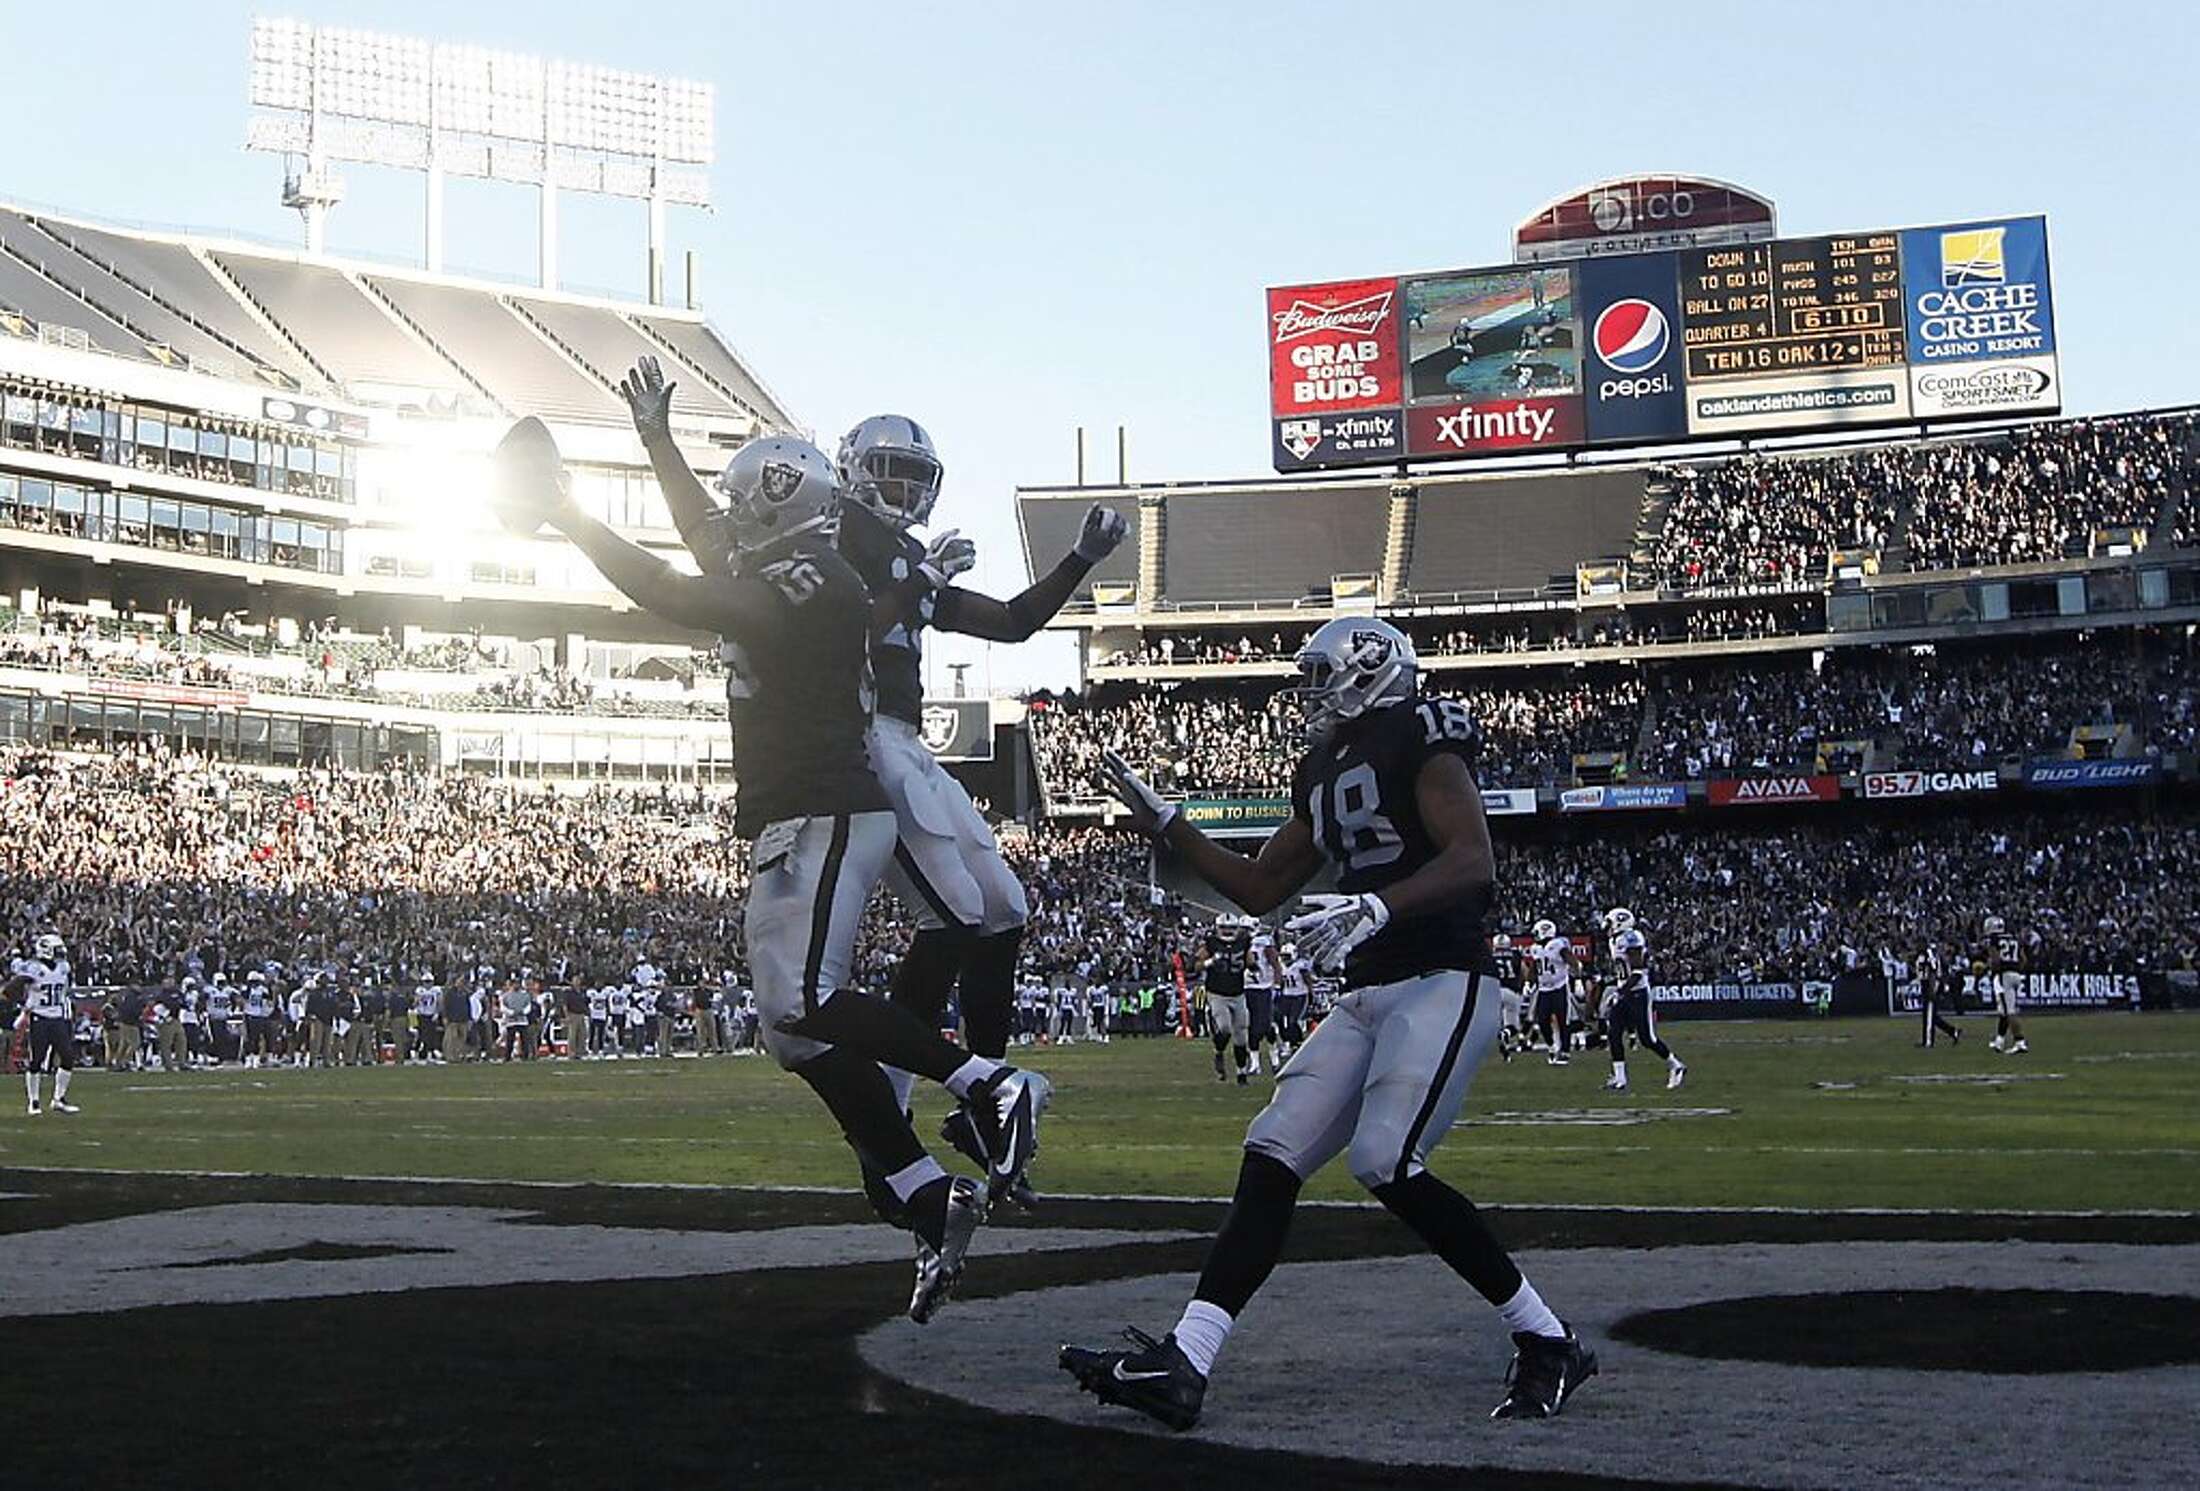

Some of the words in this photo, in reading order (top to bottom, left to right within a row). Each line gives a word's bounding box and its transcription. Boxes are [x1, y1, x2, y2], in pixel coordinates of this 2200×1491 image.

[1707, 252, 1744, 268] DOWN
[1753, 250, 1761, 264] 1
[1700, 276, 1718, 290] TO
[1727, 275, 1745, 288] GO
[1751, 271, 1767, 285] 10
[1687, 300, 1723, 315] BALL
[1728, 298, 1747, 312] ON
[1750, 294, 1769, 309] 27
[1918, 283, 2038, 316] CACHE
[1273, 307, 1390, 332] Budweiser
[1805, 308, 1868, 327] 6:10
[1920, 310, 2041, 341] CREEK
[1685, 324, 1749, 343] QUARTER
[1757, 322, 1767, 336] 4
[1291, 341, 1379, 367] GRAB
[1706, 352, 1742, 370] TEN
[1749, 349, 1771, 367] 16
[1778, 345, 1816, 364] OAK
[1821, 342, 1844, 361] 12
[1923, 341, 1980, 357] CASINO
[1987, 336, 2042, 352] RESORT
[1307, 363, 1365, 380] SOME
[1293, 376, 1379, 403] BUDS
[1601, 373, 1671, 401] pepsi
[1942, 384, 2033, 400] SPORTSNET
[1701, 388, 1892, 415] oaklandathletics.com
[1336, 416, 1393, 439] xfinity
[1436, 404, 1553, 447] xfinity
[1415, 700, 1474, 744] 18
[1868, 774, 1920, 795] 95.7
[1931, 771, 1998, 792] GAME
[2032, 768, 2079, 782] BUD
[2089, 763, 2152, 779] LIGHT
[1737, 777, 1812, 798] AVAYA
[1185, 807, 1223, 820] DOWN
[1227, 807, 1243, 819] TO
[1309, 763, 1405, 870] 18
[1999, 939, 2019, 962] 27
[1715, 983, 1741, 1000] FOR
[1744, 983, 1797, 1000] TICKETS
[2030, 974, 2080, 997] BLACK
[2084, 974, 2125, 997] HOLE
